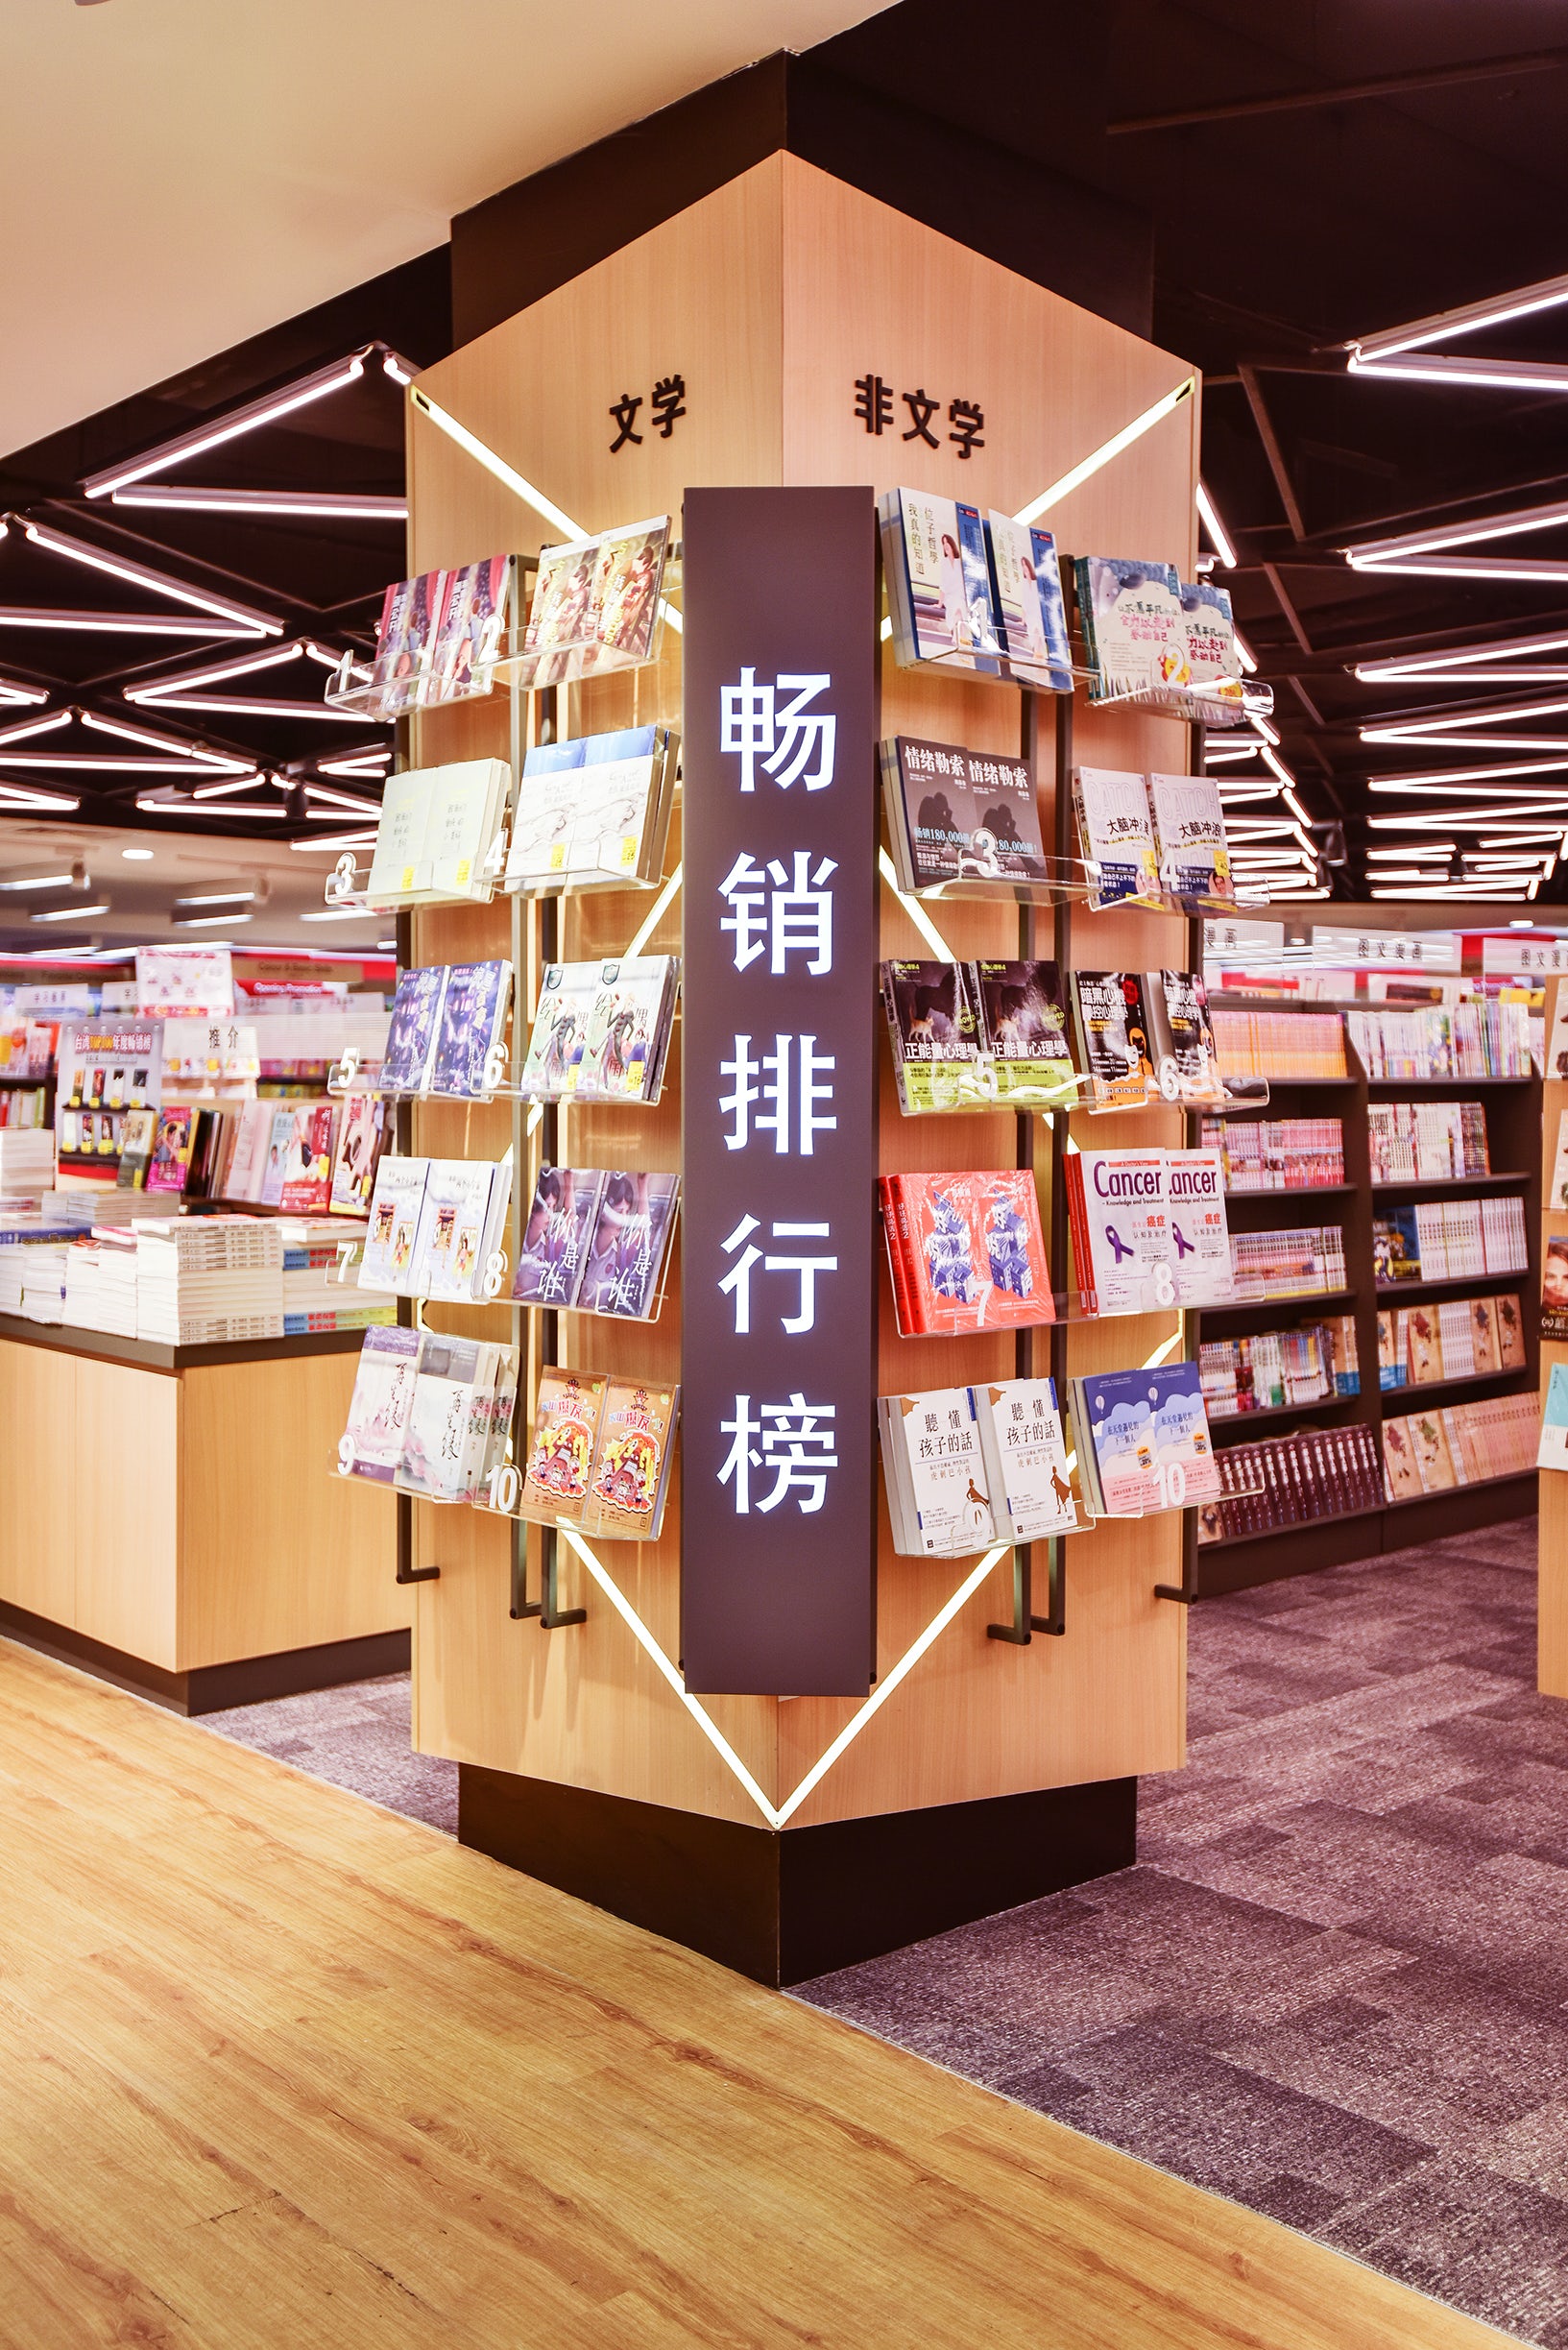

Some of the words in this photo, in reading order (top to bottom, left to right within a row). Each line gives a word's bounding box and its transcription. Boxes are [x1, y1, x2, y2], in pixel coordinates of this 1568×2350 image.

[609, 374, 686, 453] 文学
[855, 374, 984, 459] 非文学
[1186, 636, 1229, 652] 力以赴到
[972, 827, 999, 878] 3
[1159, 846, 1180, 891] 4
[484, 1042, 507, 1089] 6
[976, 1052, 999, 1098] 5
[1159, 1054, 1180, 1102] 6
[717, 666, 838, 1515] 畅销排行榜
[1094, 1160, 1162, 1198] Cancer
[1169, 1171, 1218, 1196] ancer
[1106, 1199, 1132, 1207] Knowledge
[337, 1241, 358, 1284] 7
[483, 1251, 505, 1296] 8
[1154, 1260, 1176, 1307] 8
[966, 1280, 994, 1327] 7
[338, 1434, 355, 1476] 9
[919, 1431, 973, 1459] 孩子的話
[1006, 1419, 1056, 1446] 孩子的話
[485, 1464, 519, 1514] 10
[1152, 1462, 1186, 1509] 10
